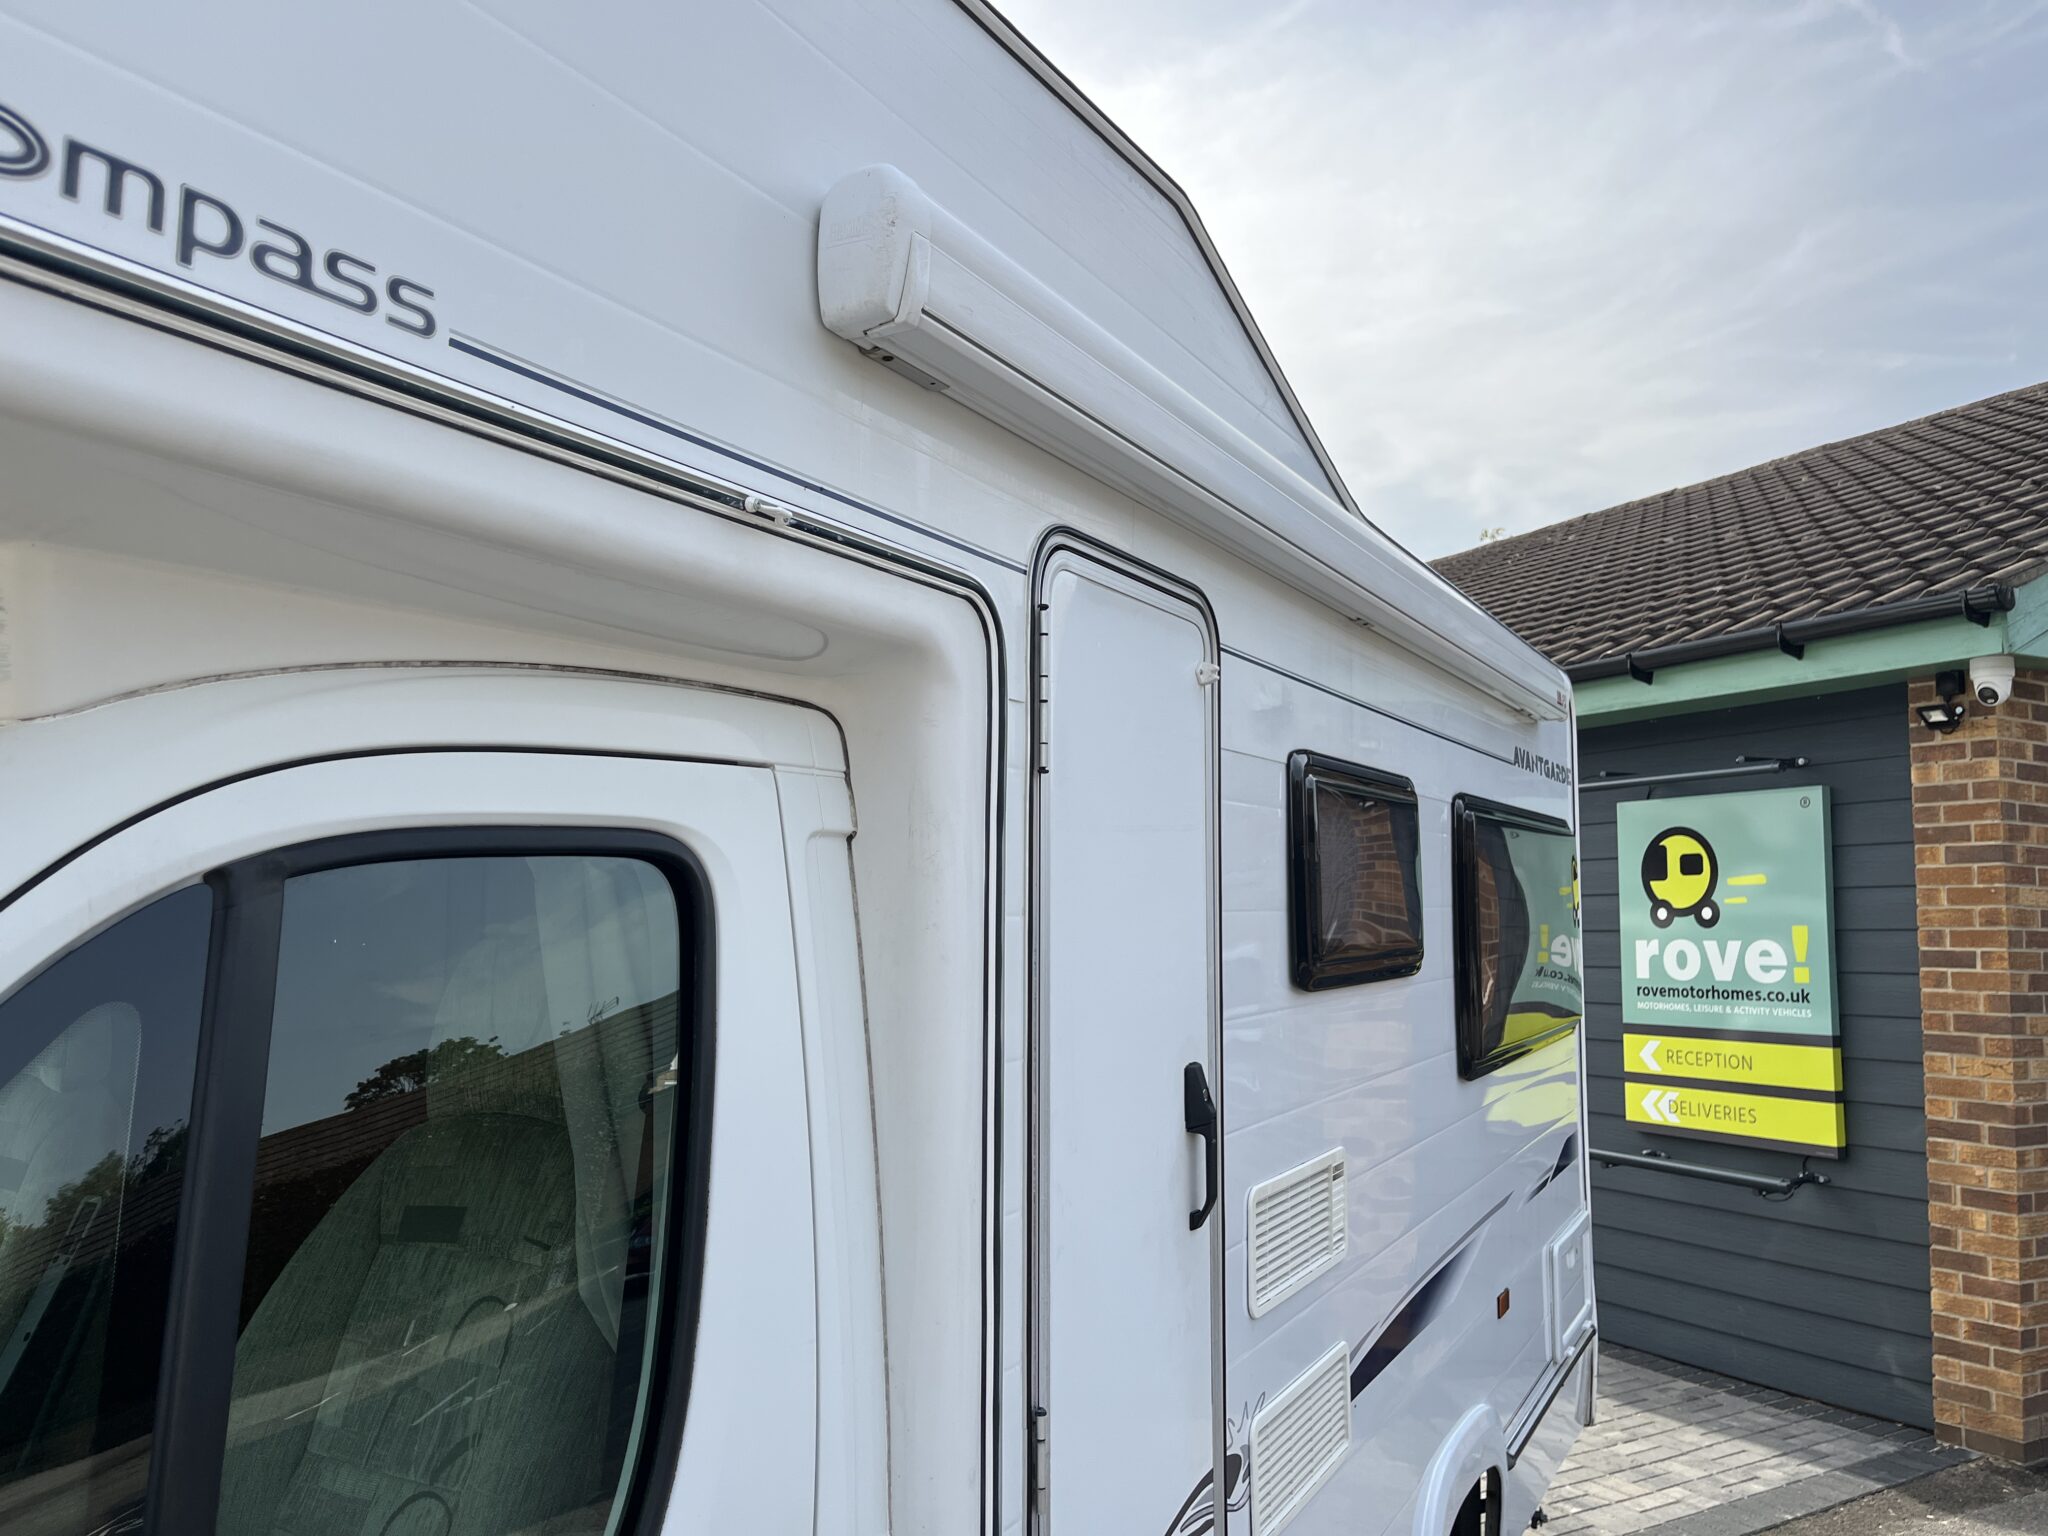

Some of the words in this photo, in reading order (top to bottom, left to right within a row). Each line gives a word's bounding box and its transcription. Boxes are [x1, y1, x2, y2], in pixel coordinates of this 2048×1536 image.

[1635, 925, 1810, 984] rove!
[1636, 985, 1811, 1004] rovemotorhomes.co.uk
[1637, 1001, 1692, 1013] MOTORHOMES,
[1693, 1004, 1723, 1014] LEISURE
[1725, 1006, 1732, 1014] &
[1733, 1006, 1770, 1016] ACTIVITY
[1772, 1008, 1812, 1018] VEHICLES
[1666, 1049, 1753, 1071] RECEPTION
[1668, 1099, 1757, 1124] DELIVERIES
